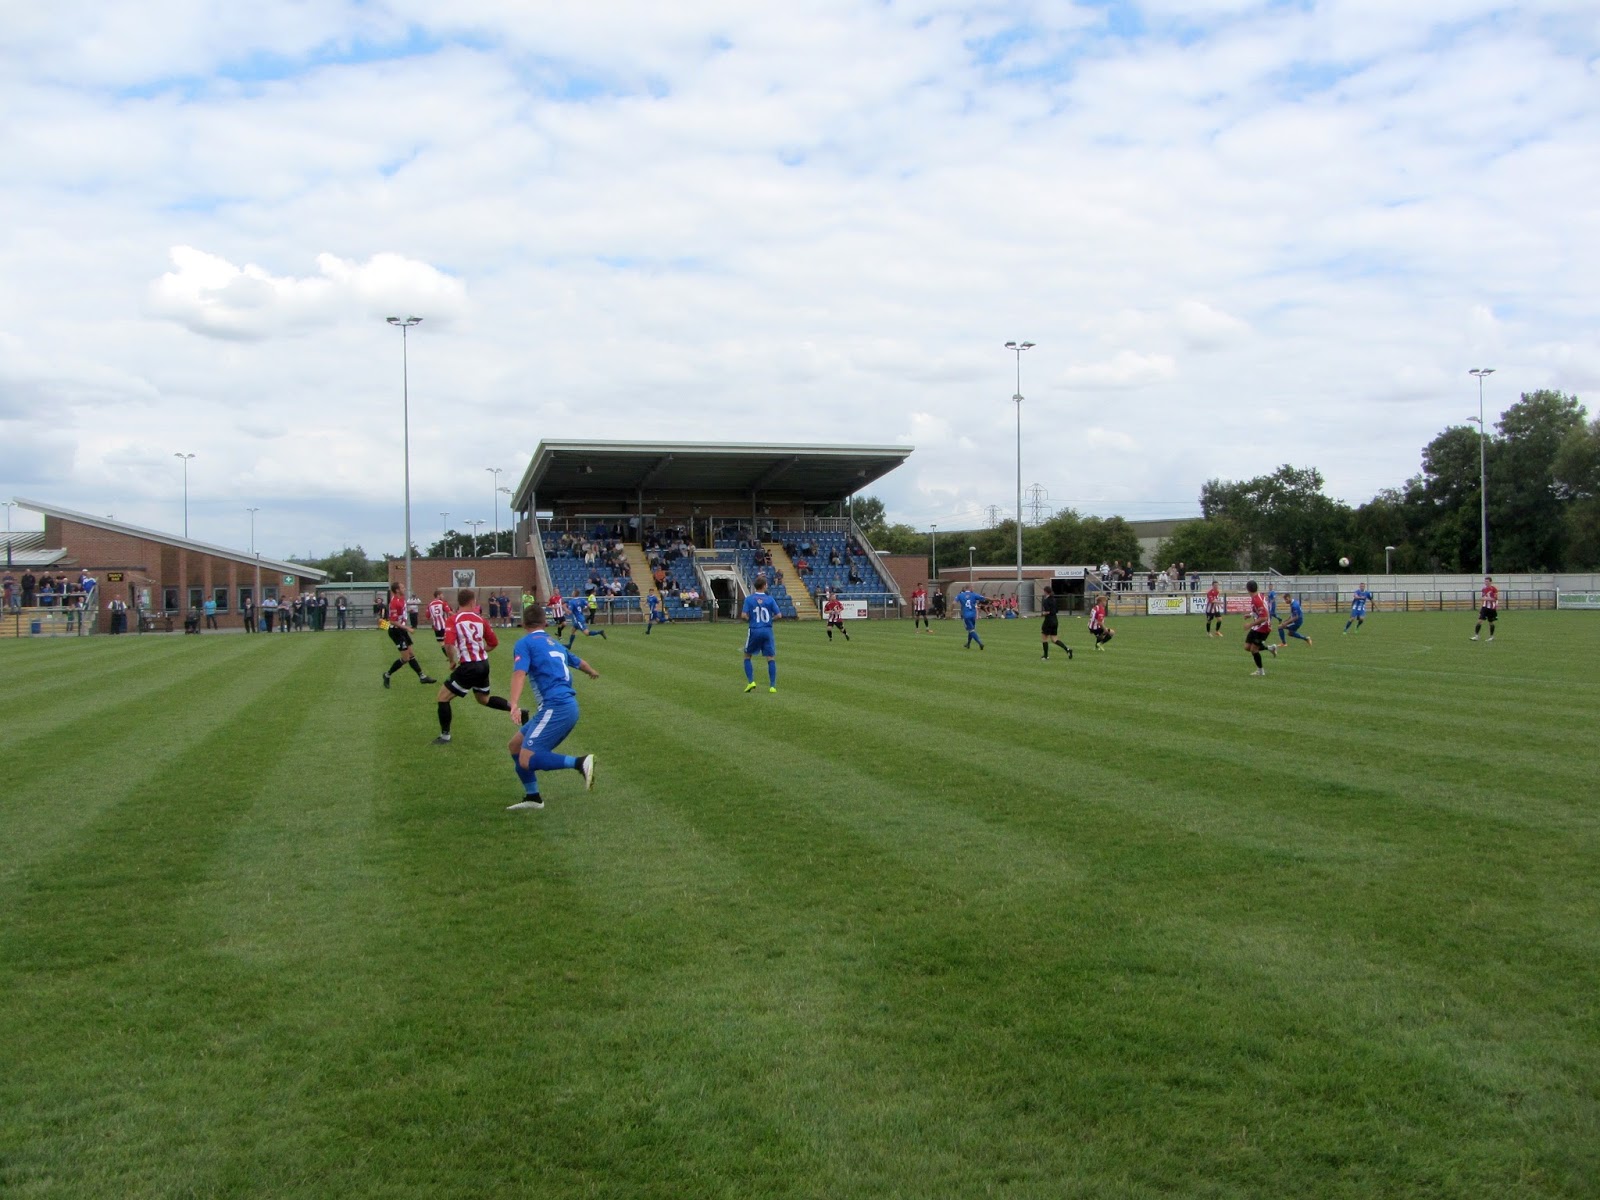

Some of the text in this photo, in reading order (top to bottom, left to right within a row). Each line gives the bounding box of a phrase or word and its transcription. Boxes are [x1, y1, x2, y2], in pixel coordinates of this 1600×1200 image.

[434, 605, 441, 615] 5
[965, 599, 972, 610] 4
[1152, 598, 1183, 608] SUBWAY
[752, 606, 770, 623] 10
[469, 623, 482, 642] 2
[548, 650, 570, 682] 7
